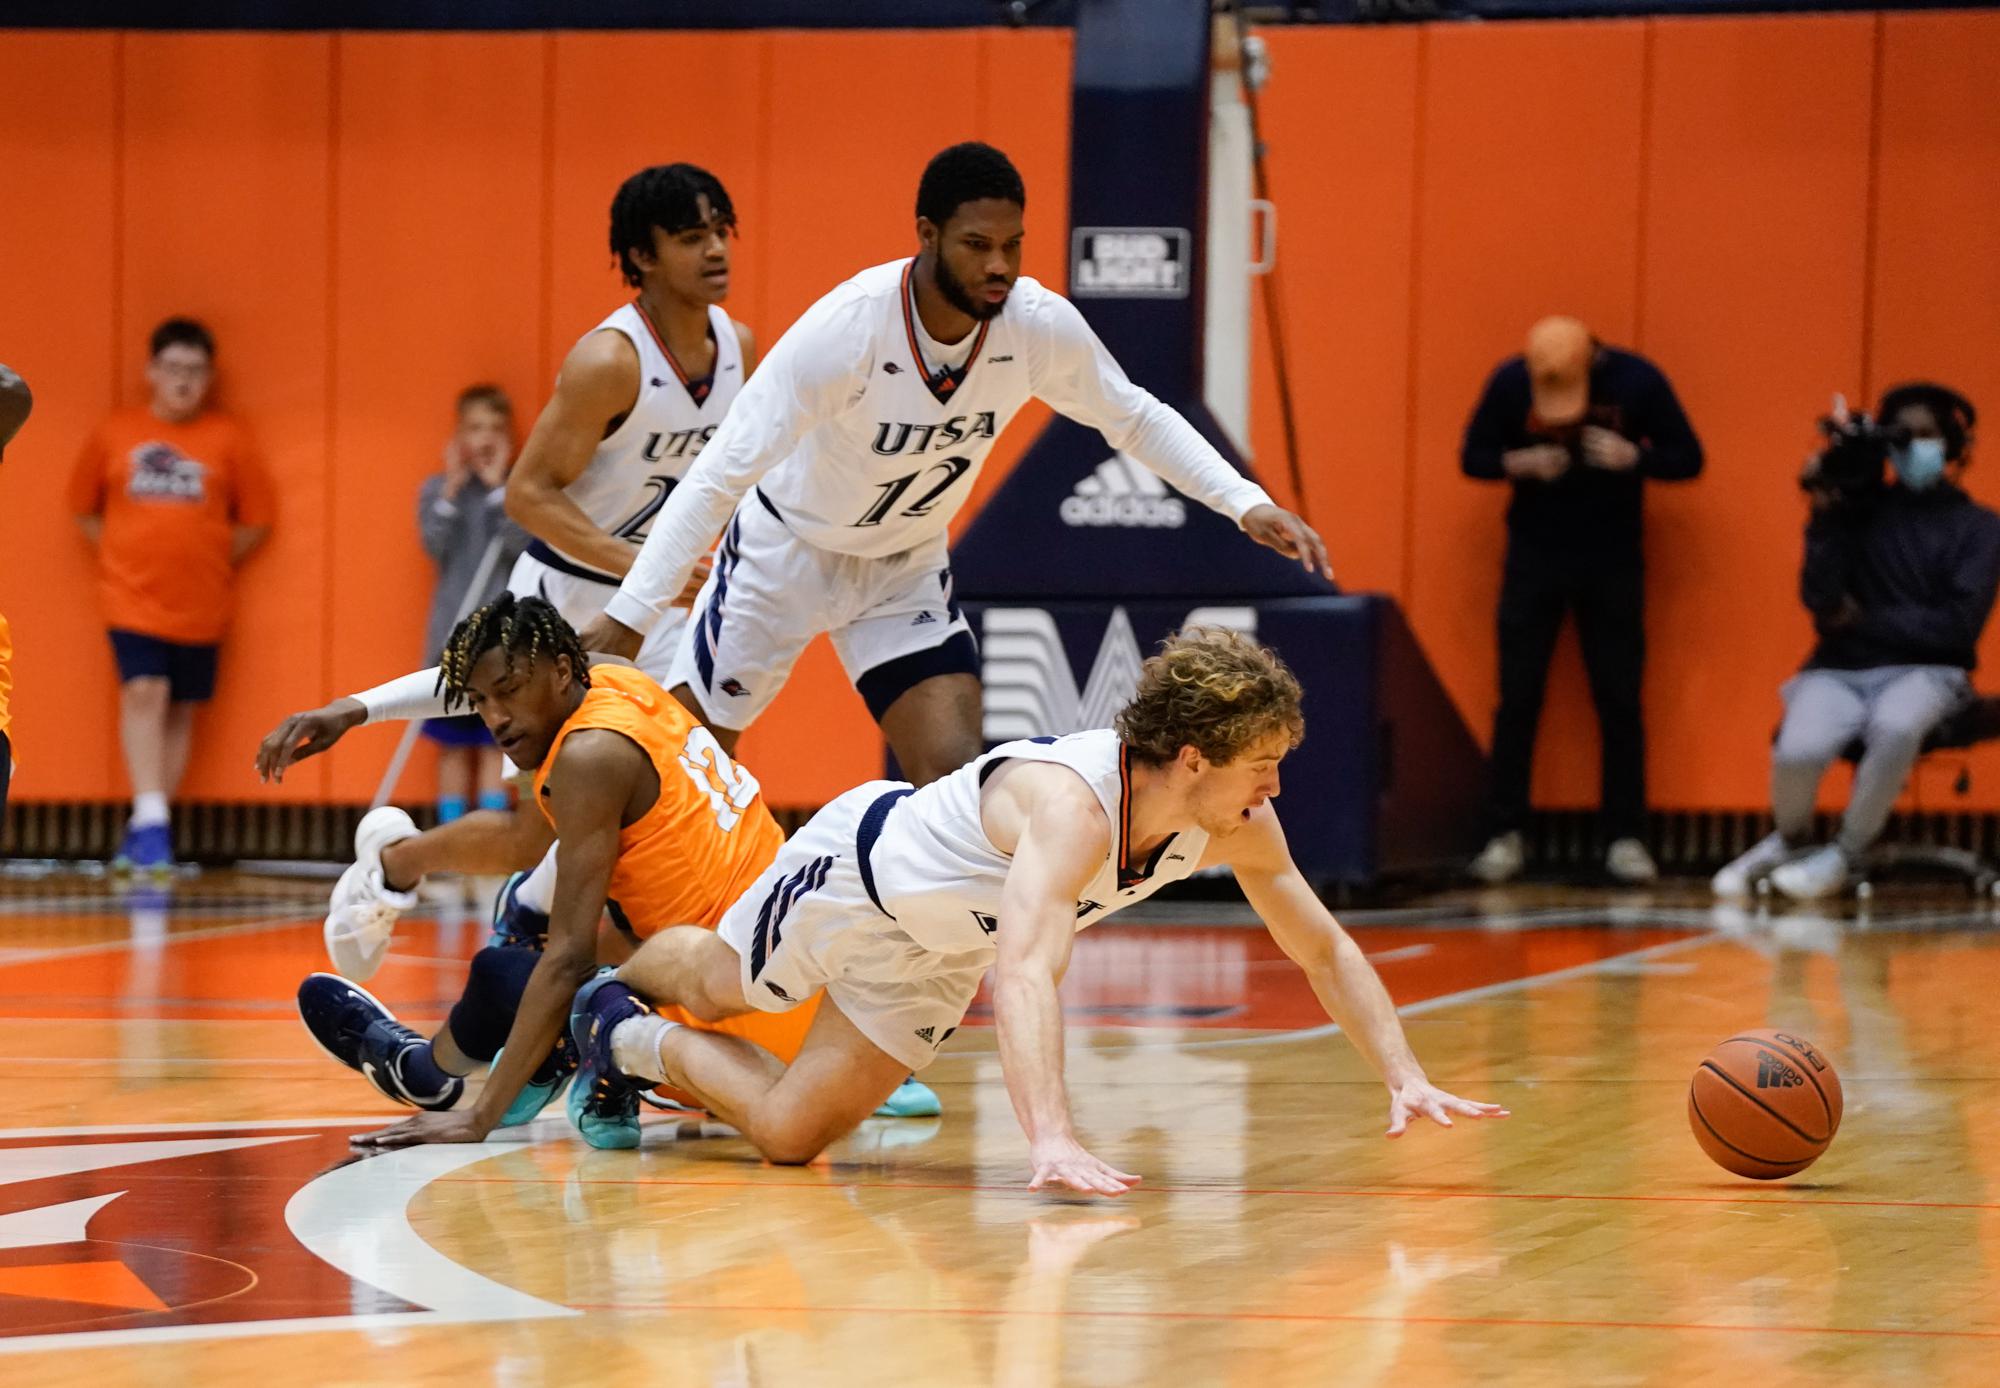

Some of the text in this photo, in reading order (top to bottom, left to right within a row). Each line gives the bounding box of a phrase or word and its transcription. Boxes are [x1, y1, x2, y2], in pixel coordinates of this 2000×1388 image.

[641, 423, 719, 462] UTS
[871, 411, 996, 456] UTSA
[846, 456, 971, 527] 12
[1060, 496, 1186, 528] adidas
[1756, 1049, 1804, 1087] adidas
[1775, 1033, 1826, 1073] PRO
